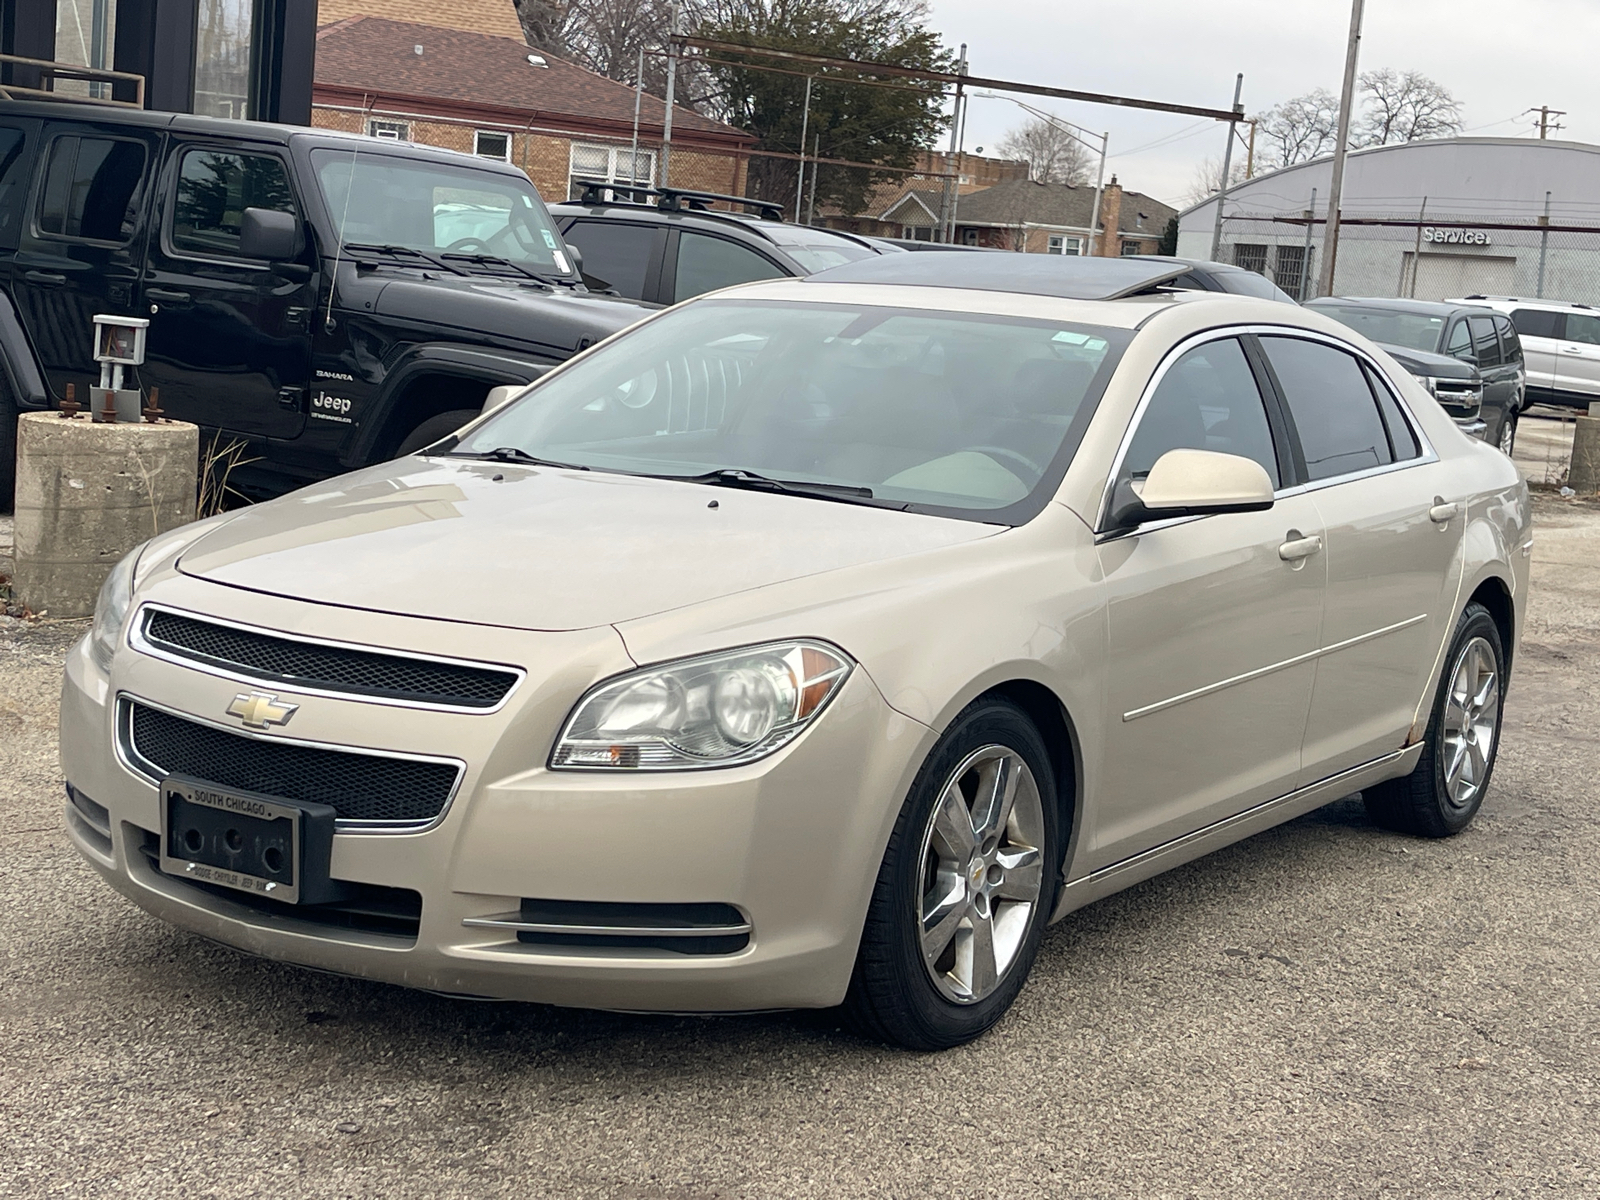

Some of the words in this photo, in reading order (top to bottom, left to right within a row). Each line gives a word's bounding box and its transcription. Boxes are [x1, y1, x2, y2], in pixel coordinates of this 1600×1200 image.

[316, 370, 353, 381] SAHARA
[313, 391, 351, 414] Jeep
[194, 789, 224, 806] SOUTH
[226, 797, 265, 816] CHICAGO
[194, 866, 212, 879] DODGE
[242, 878, 253, 888] JEEP
